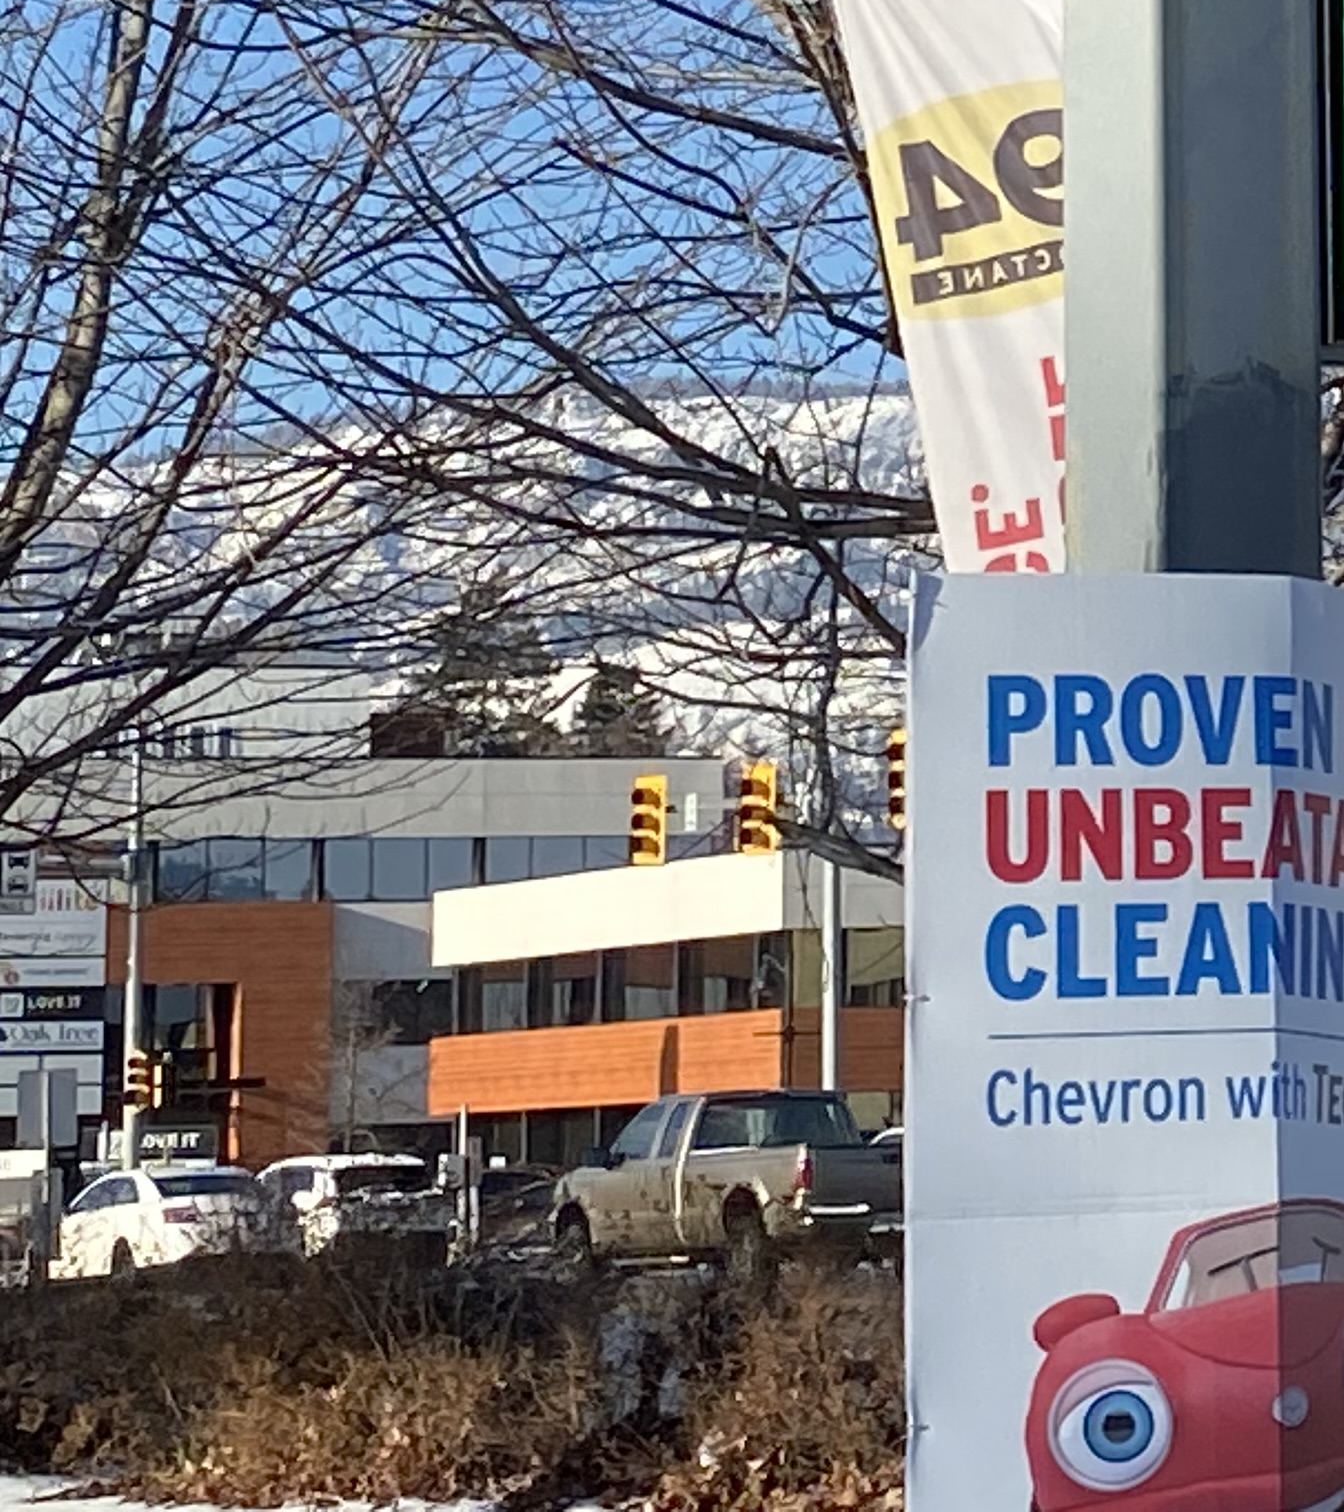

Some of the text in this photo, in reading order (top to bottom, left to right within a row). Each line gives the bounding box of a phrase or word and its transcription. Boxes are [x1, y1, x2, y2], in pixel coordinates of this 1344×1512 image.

[986, 673, 1334, 775] PROVEN
[986, 1068, 1206, 1128] Chevron
[1225, 1060, 1306, 1122] with
